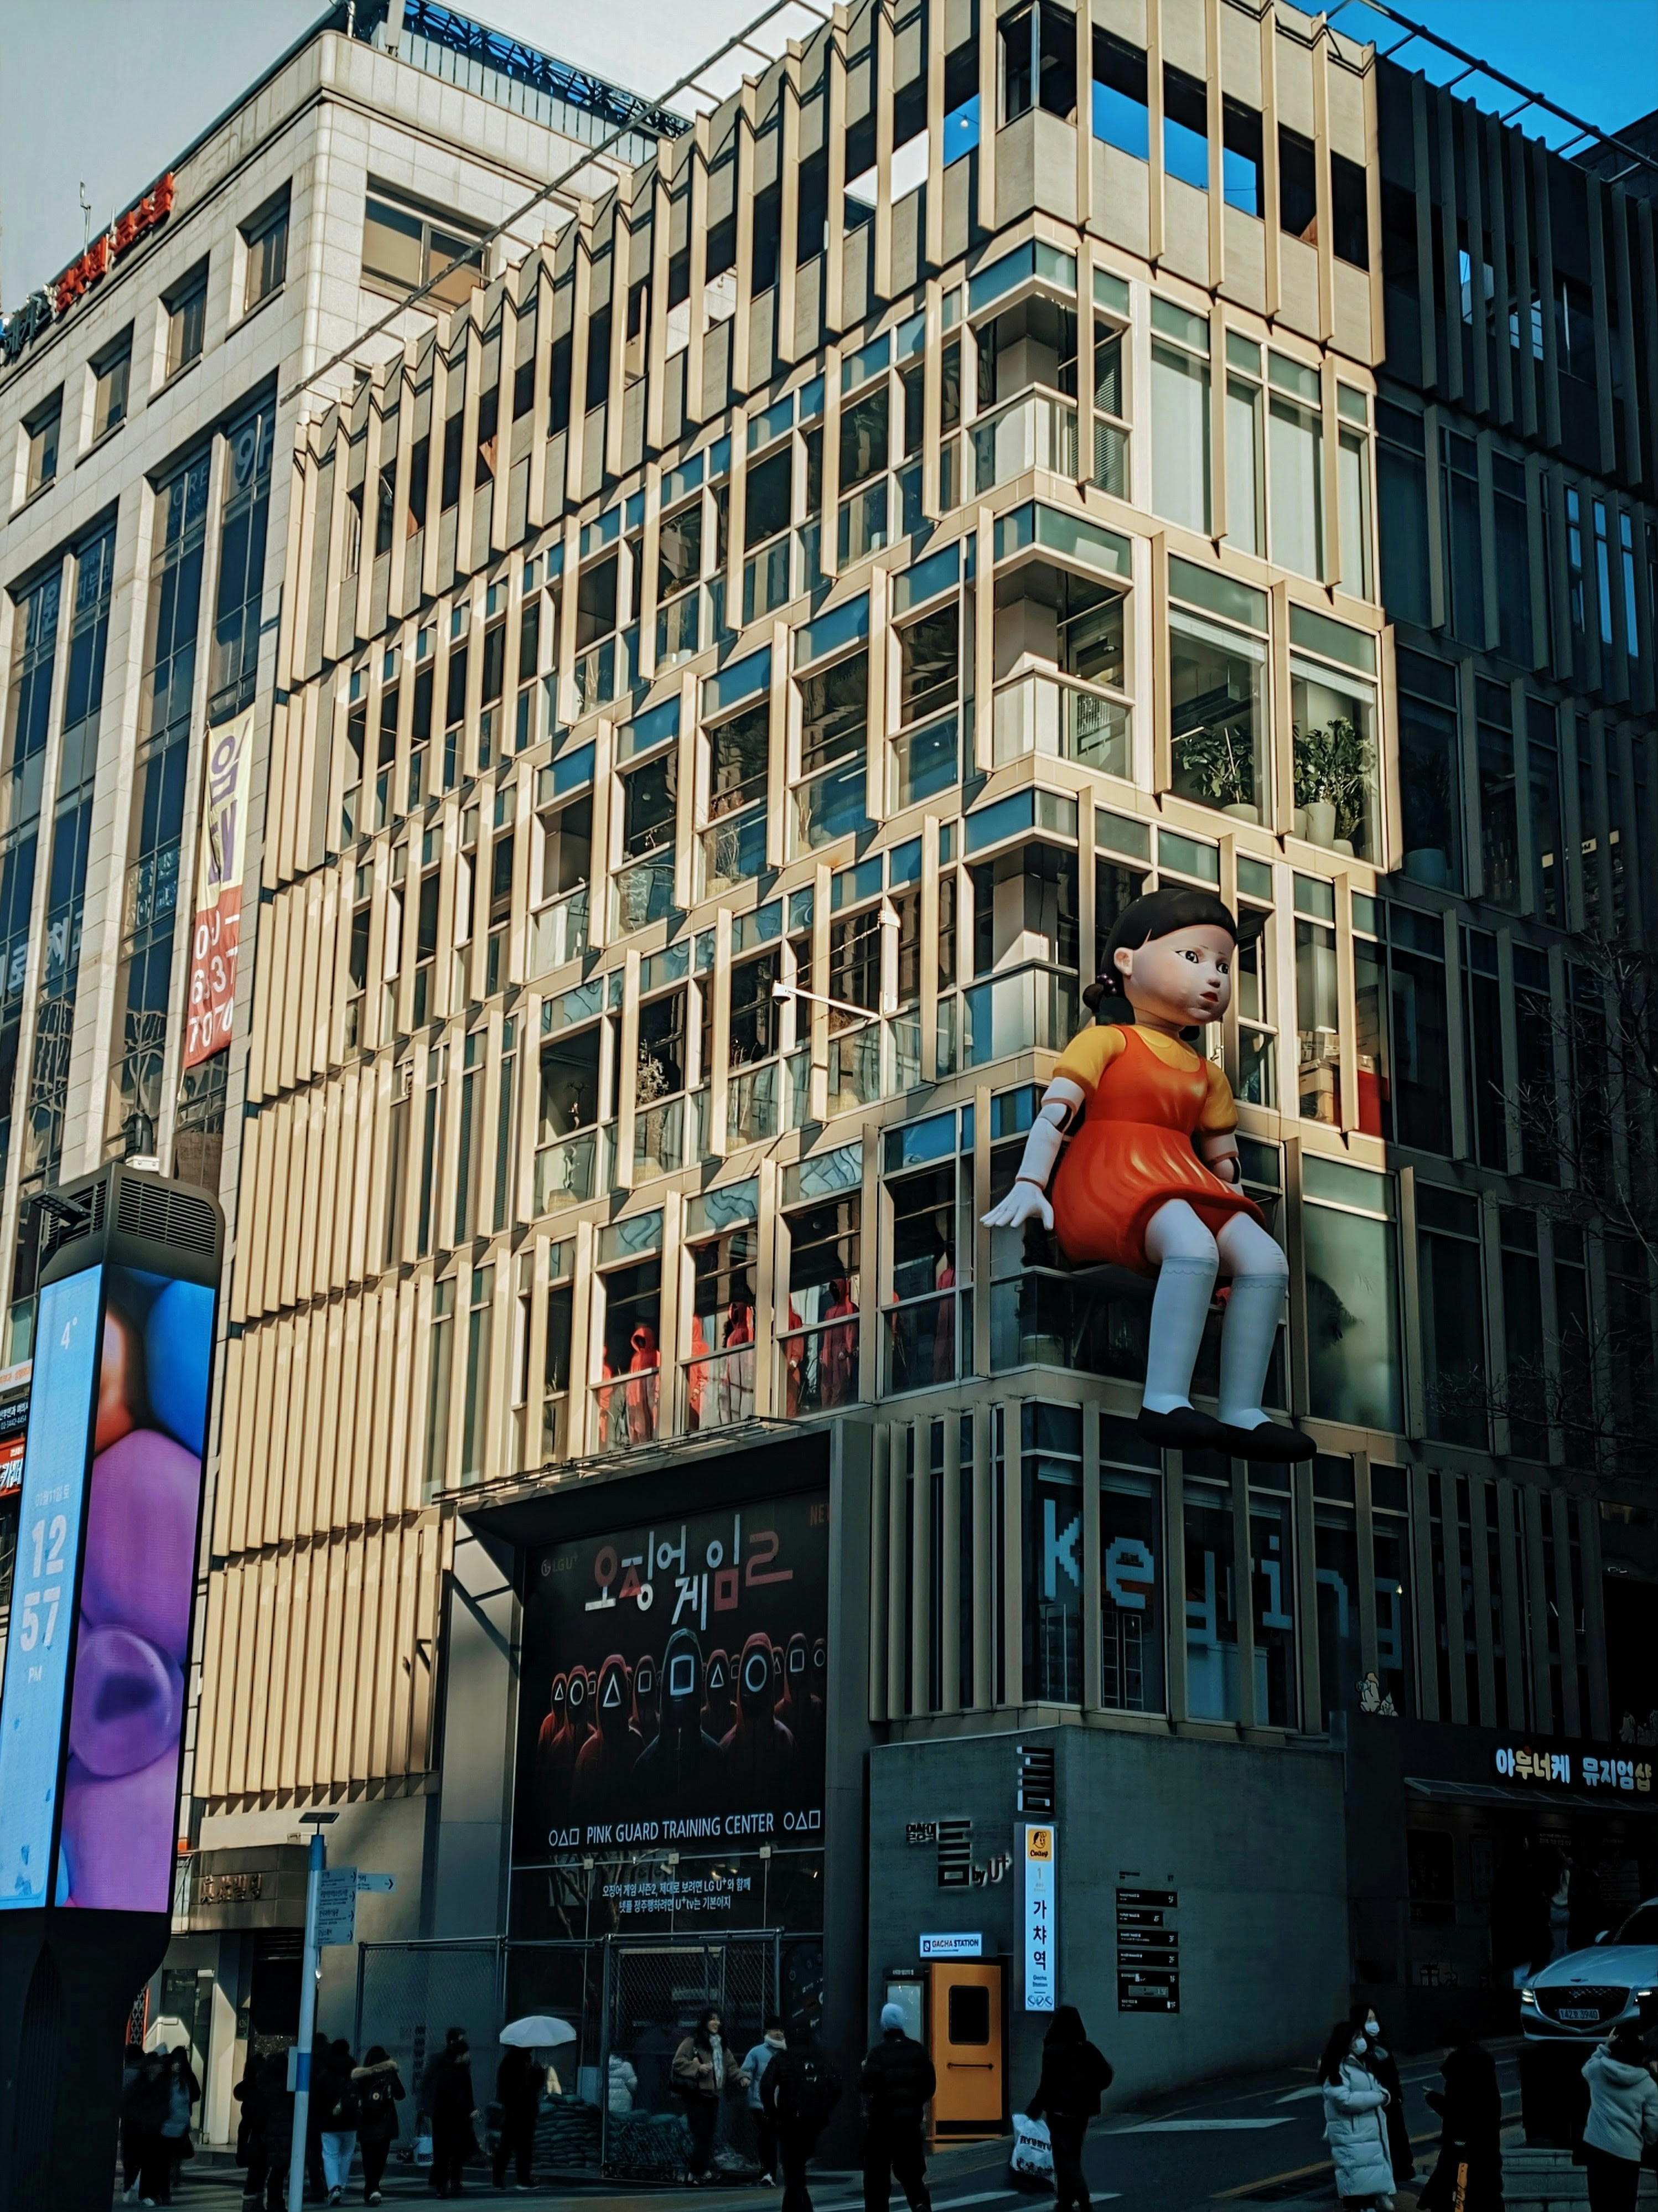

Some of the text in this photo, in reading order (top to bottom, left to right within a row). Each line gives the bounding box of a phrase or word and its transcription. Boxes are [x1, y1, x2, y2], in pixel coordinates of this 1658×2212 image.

[32, 1514, 66, 1578] 12
[20, 1586, 61, 1652] 57
[28, 1666, 43, 1683] PM
[1582, 1757, 1652, 1792] 뮤지엄샵
[587, 1812, 774, 1845] PINK GUARD TRAINING CENTER
[603, 1884, 622, 1898] 오징어
[682, 1880, 702, 1893] 보려면
[932, 1939, 979, 1948] GACHA STATION
[1033, 1899, 1047, 1971] 가챠역
